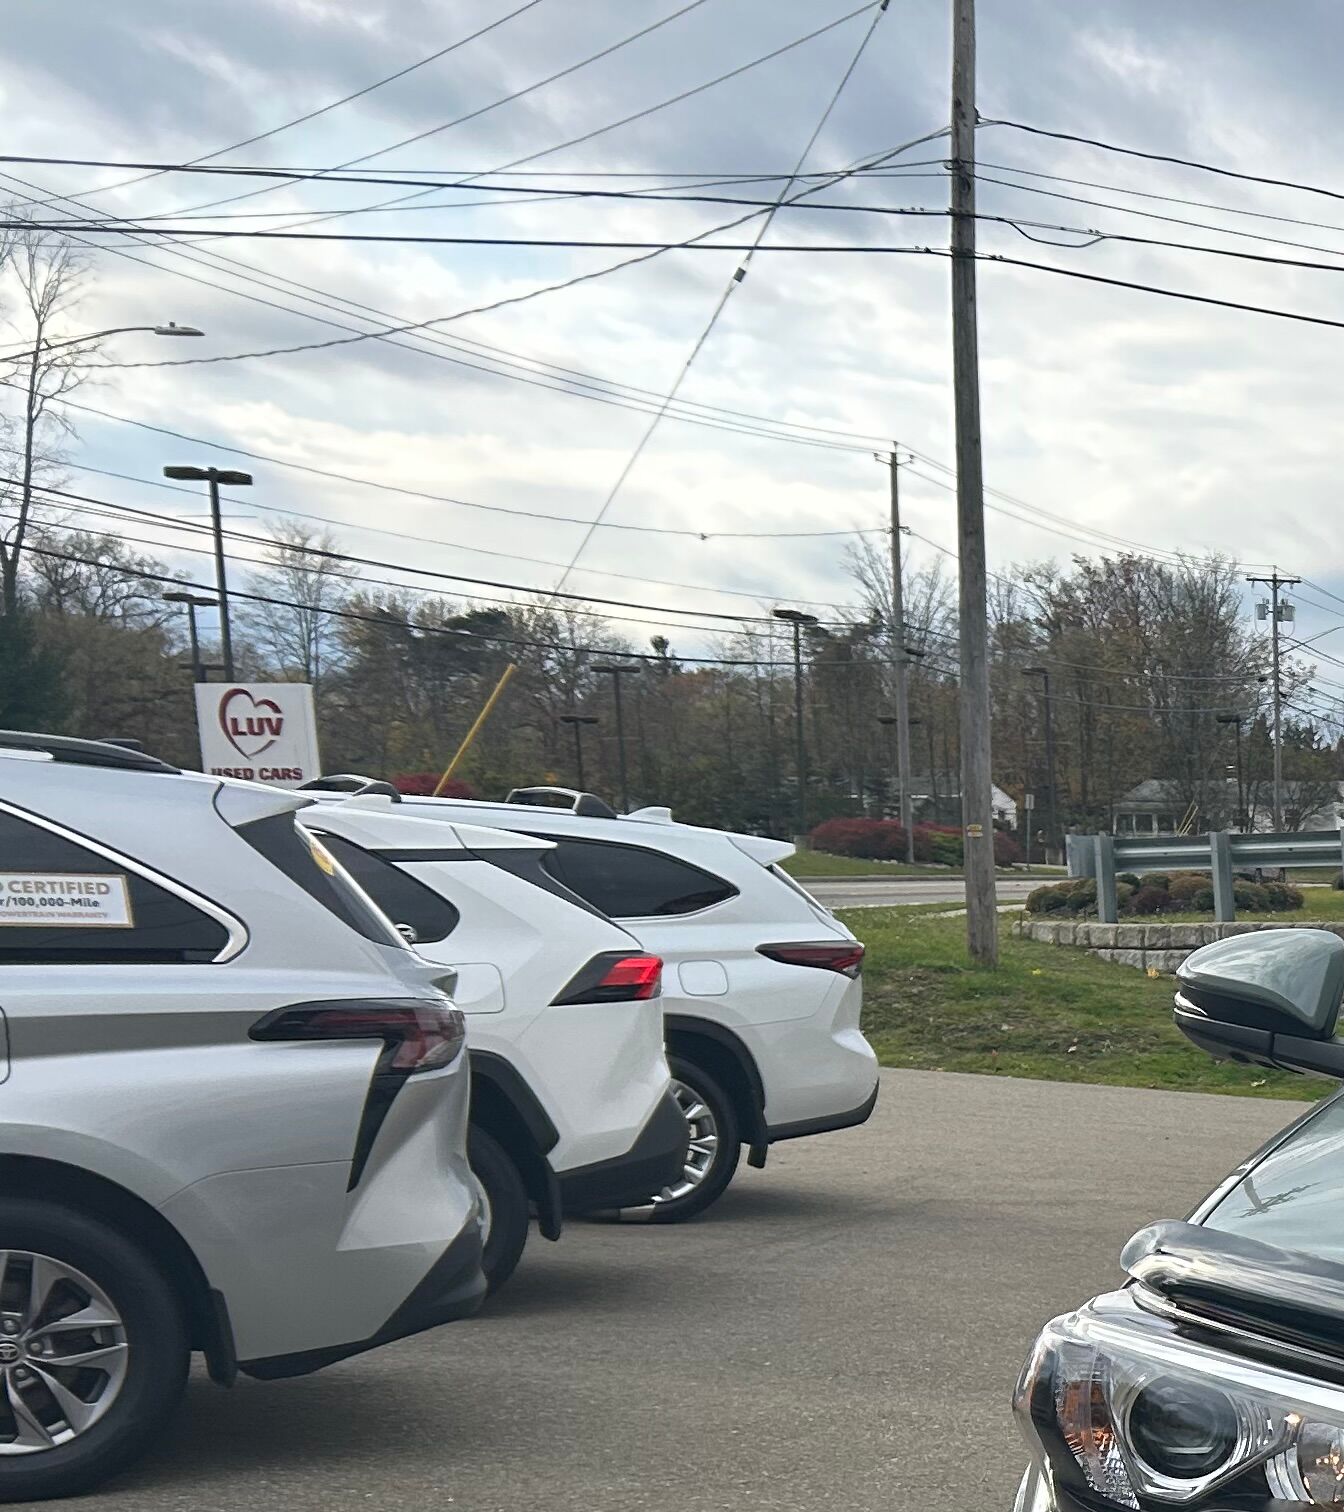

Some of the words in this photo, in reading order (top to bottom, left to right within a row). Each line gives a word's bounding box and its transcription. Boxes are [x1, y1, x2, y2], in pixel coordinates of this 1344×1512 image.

[230, 717, 284, 736] LUV
[210, 767, 254, 780] USED
[259, 767, 303, 780] CARS
[7, 880, 110, 895] CERTIFIED
